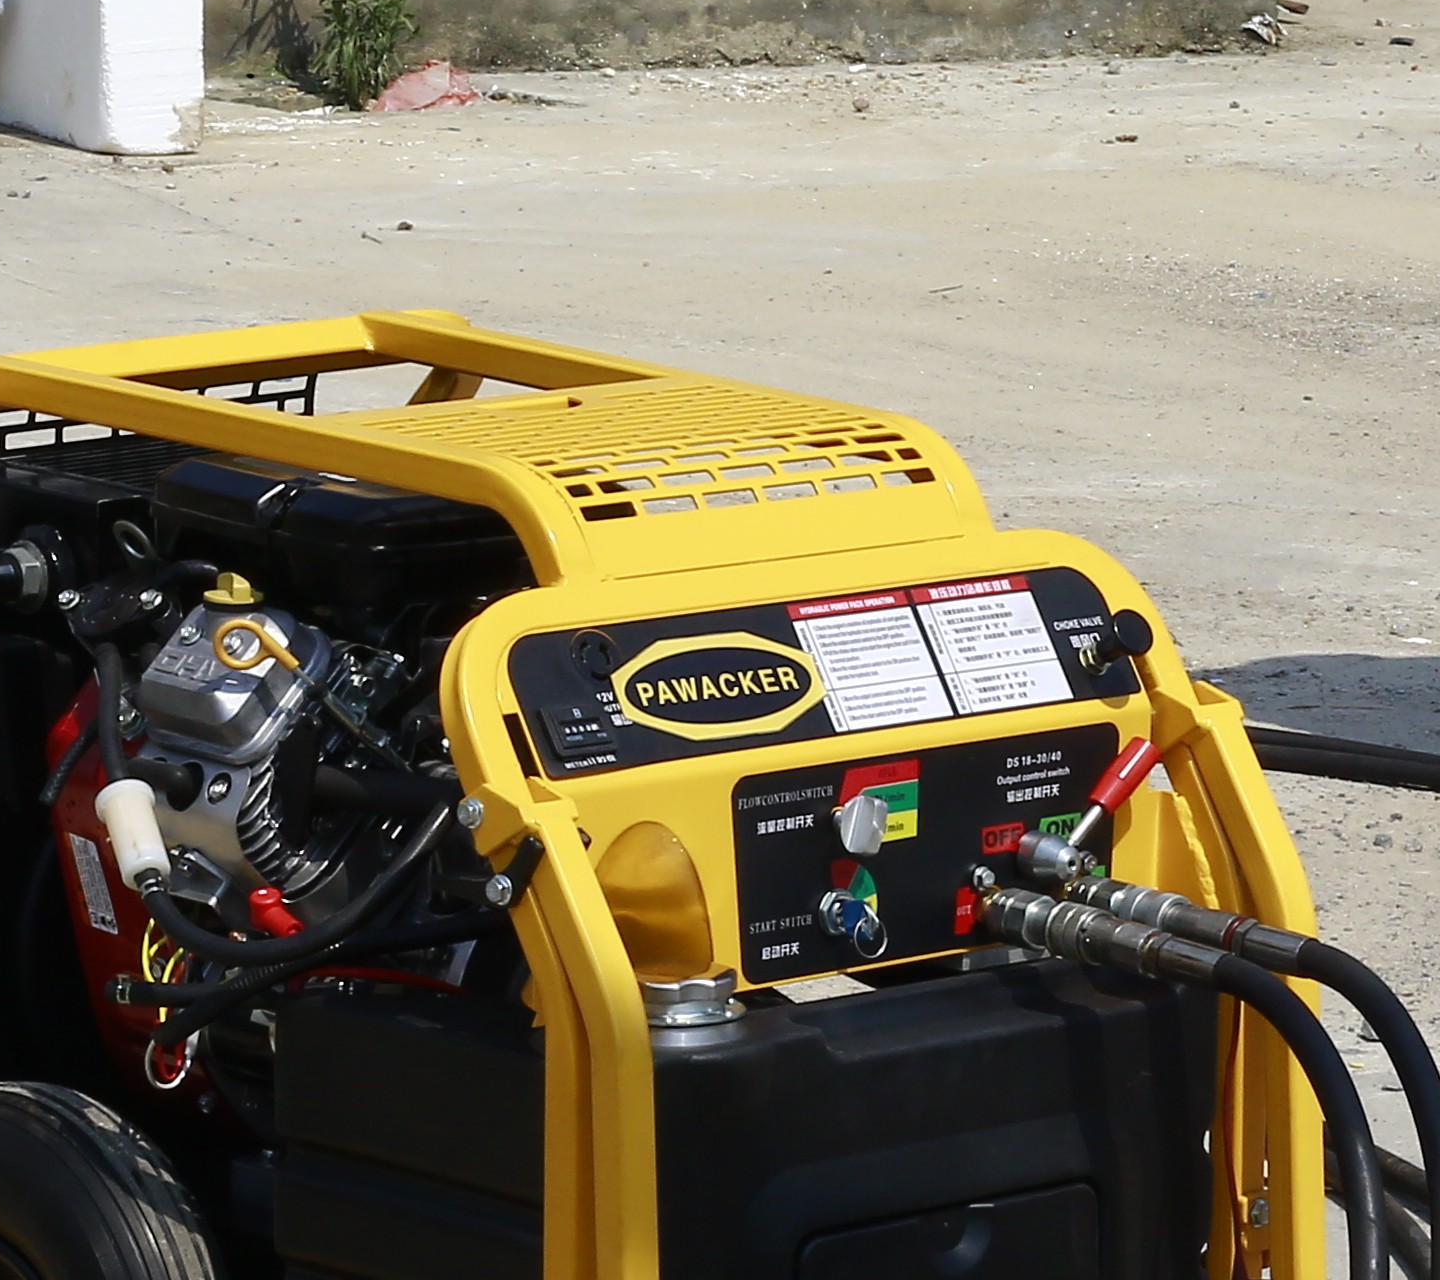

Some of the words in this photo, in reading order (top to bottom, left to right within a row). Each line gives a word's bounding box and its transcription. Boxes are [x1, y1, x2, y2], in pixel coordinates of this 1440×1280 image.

[596, 691, 614, 702] 12V
[635, 666, 800, 707] PAWACKER
[1006, 757, 1019, 768] DS
[996, 774, 1021, 786] Output
[1022, 770, 1047, 782] control
[1047, 766, 1071, 779] switch
[984, 826, 1023, 847] OFF
[1046, 818, 1075, 835] ON
[749, 920, 777, 934] START
[780, 914, 813, 930] SWITCH
